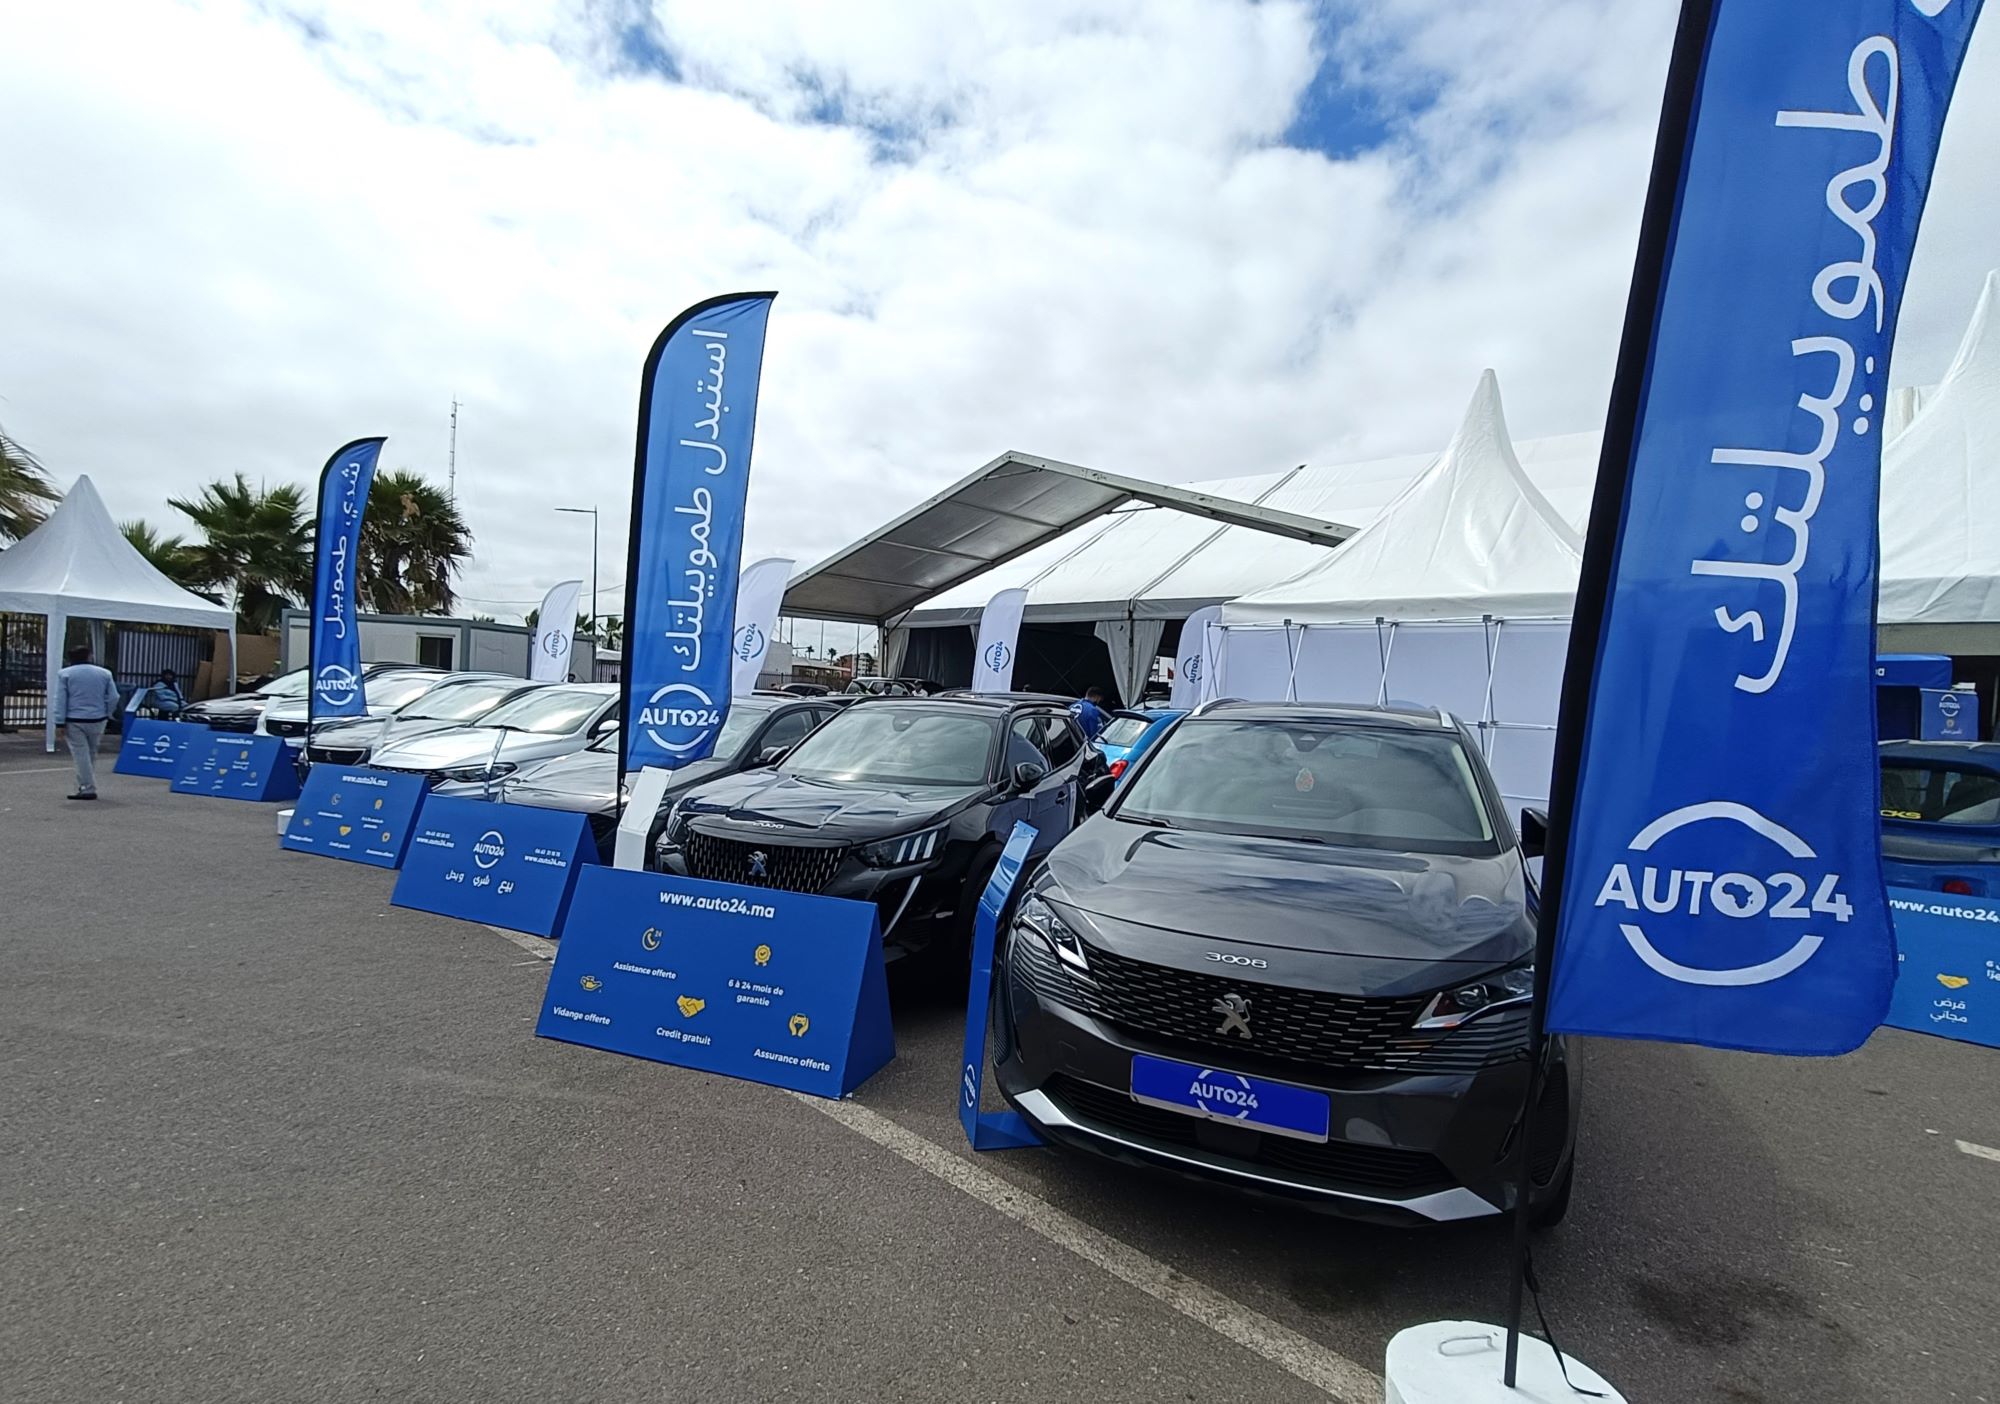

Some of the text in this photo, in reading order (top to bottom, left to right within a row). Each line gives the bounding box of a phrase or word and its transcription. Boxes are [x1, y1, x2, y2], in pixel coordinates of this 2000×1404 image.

[1690, 35, 1900, 695] طموبيلتك
[665, 329, 728, 671] استبدل طموبيلتك
[324, 536, 348, 639] طموبيل
[550, 628, 561, 659] AUTO24
[740, 622, 757, 662] AUTO24
[992, 641, 1004, 673] AUTO24
[1189, 654, 1201, 684] AUTO24
[638, 707, 720, 727] AUTO24
[473, 842, 505, 857] AUTO24
[660, 892, 775, 918] www.auto24.ma
[1595, 862, 1854, 924] AUTO24
[1889, 899, 2000, 923] ww.auto24
[613, 961, 677, 980] Assistance offerte
[1204, 951, 1269, 970] 3008
[728, 979, 734, 987] 6
[741, 981, 751, 990] 24
[752, 983, 772, 994] mois
[773, 985, 784, 996] de
[736, 994, 770, 1006] garantie
[1933, 997, 1966, 1010] قرض
[553, 1006, 611, 1025] Vidange offerte
[1930, 1010, 1968, 1023] مجاني
[656, 1027, 711, 1045] Credit gratuit
[753, 1048, 831, 1072] Assurance offerte
[1189, 1081, 1259, 1110] AUTO24
